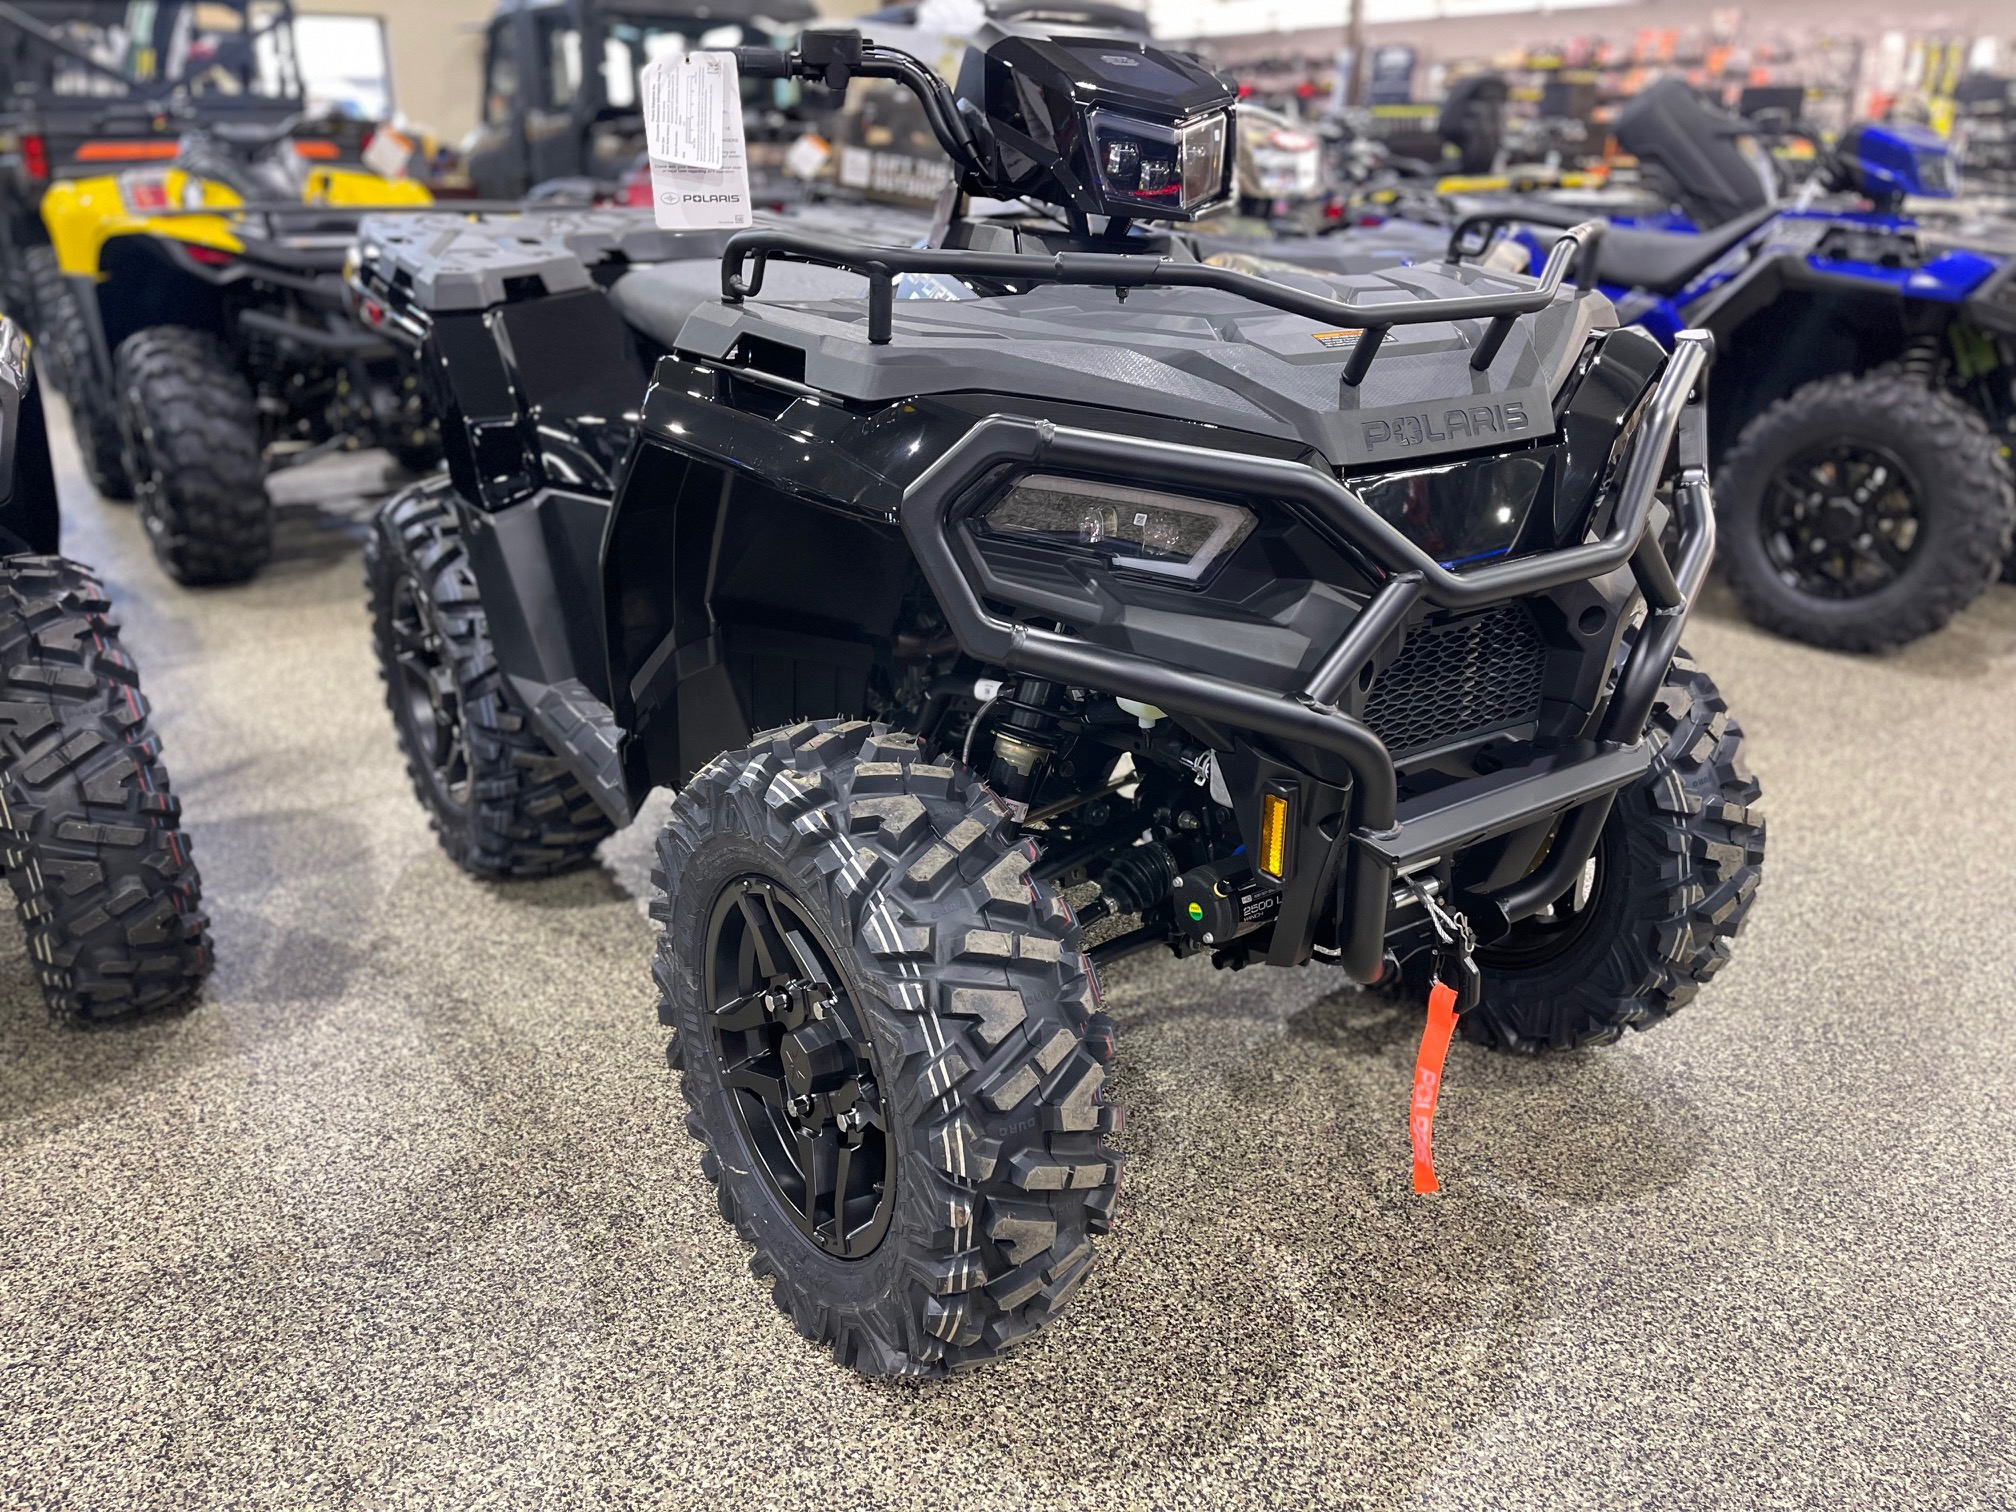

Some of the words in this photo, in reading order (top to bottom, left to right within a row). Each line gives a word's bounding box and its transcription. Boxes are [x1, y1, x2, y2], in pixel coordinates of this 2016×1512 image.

[682, 194, 741, 203] POLARIS
[1361, 401, 1529, 451] POLARIS
[1243, 899, 1274, 917] 2500
[1243, 911, 1264, 922] WINCH
[998, 1116, 1036, 1137] DURO
